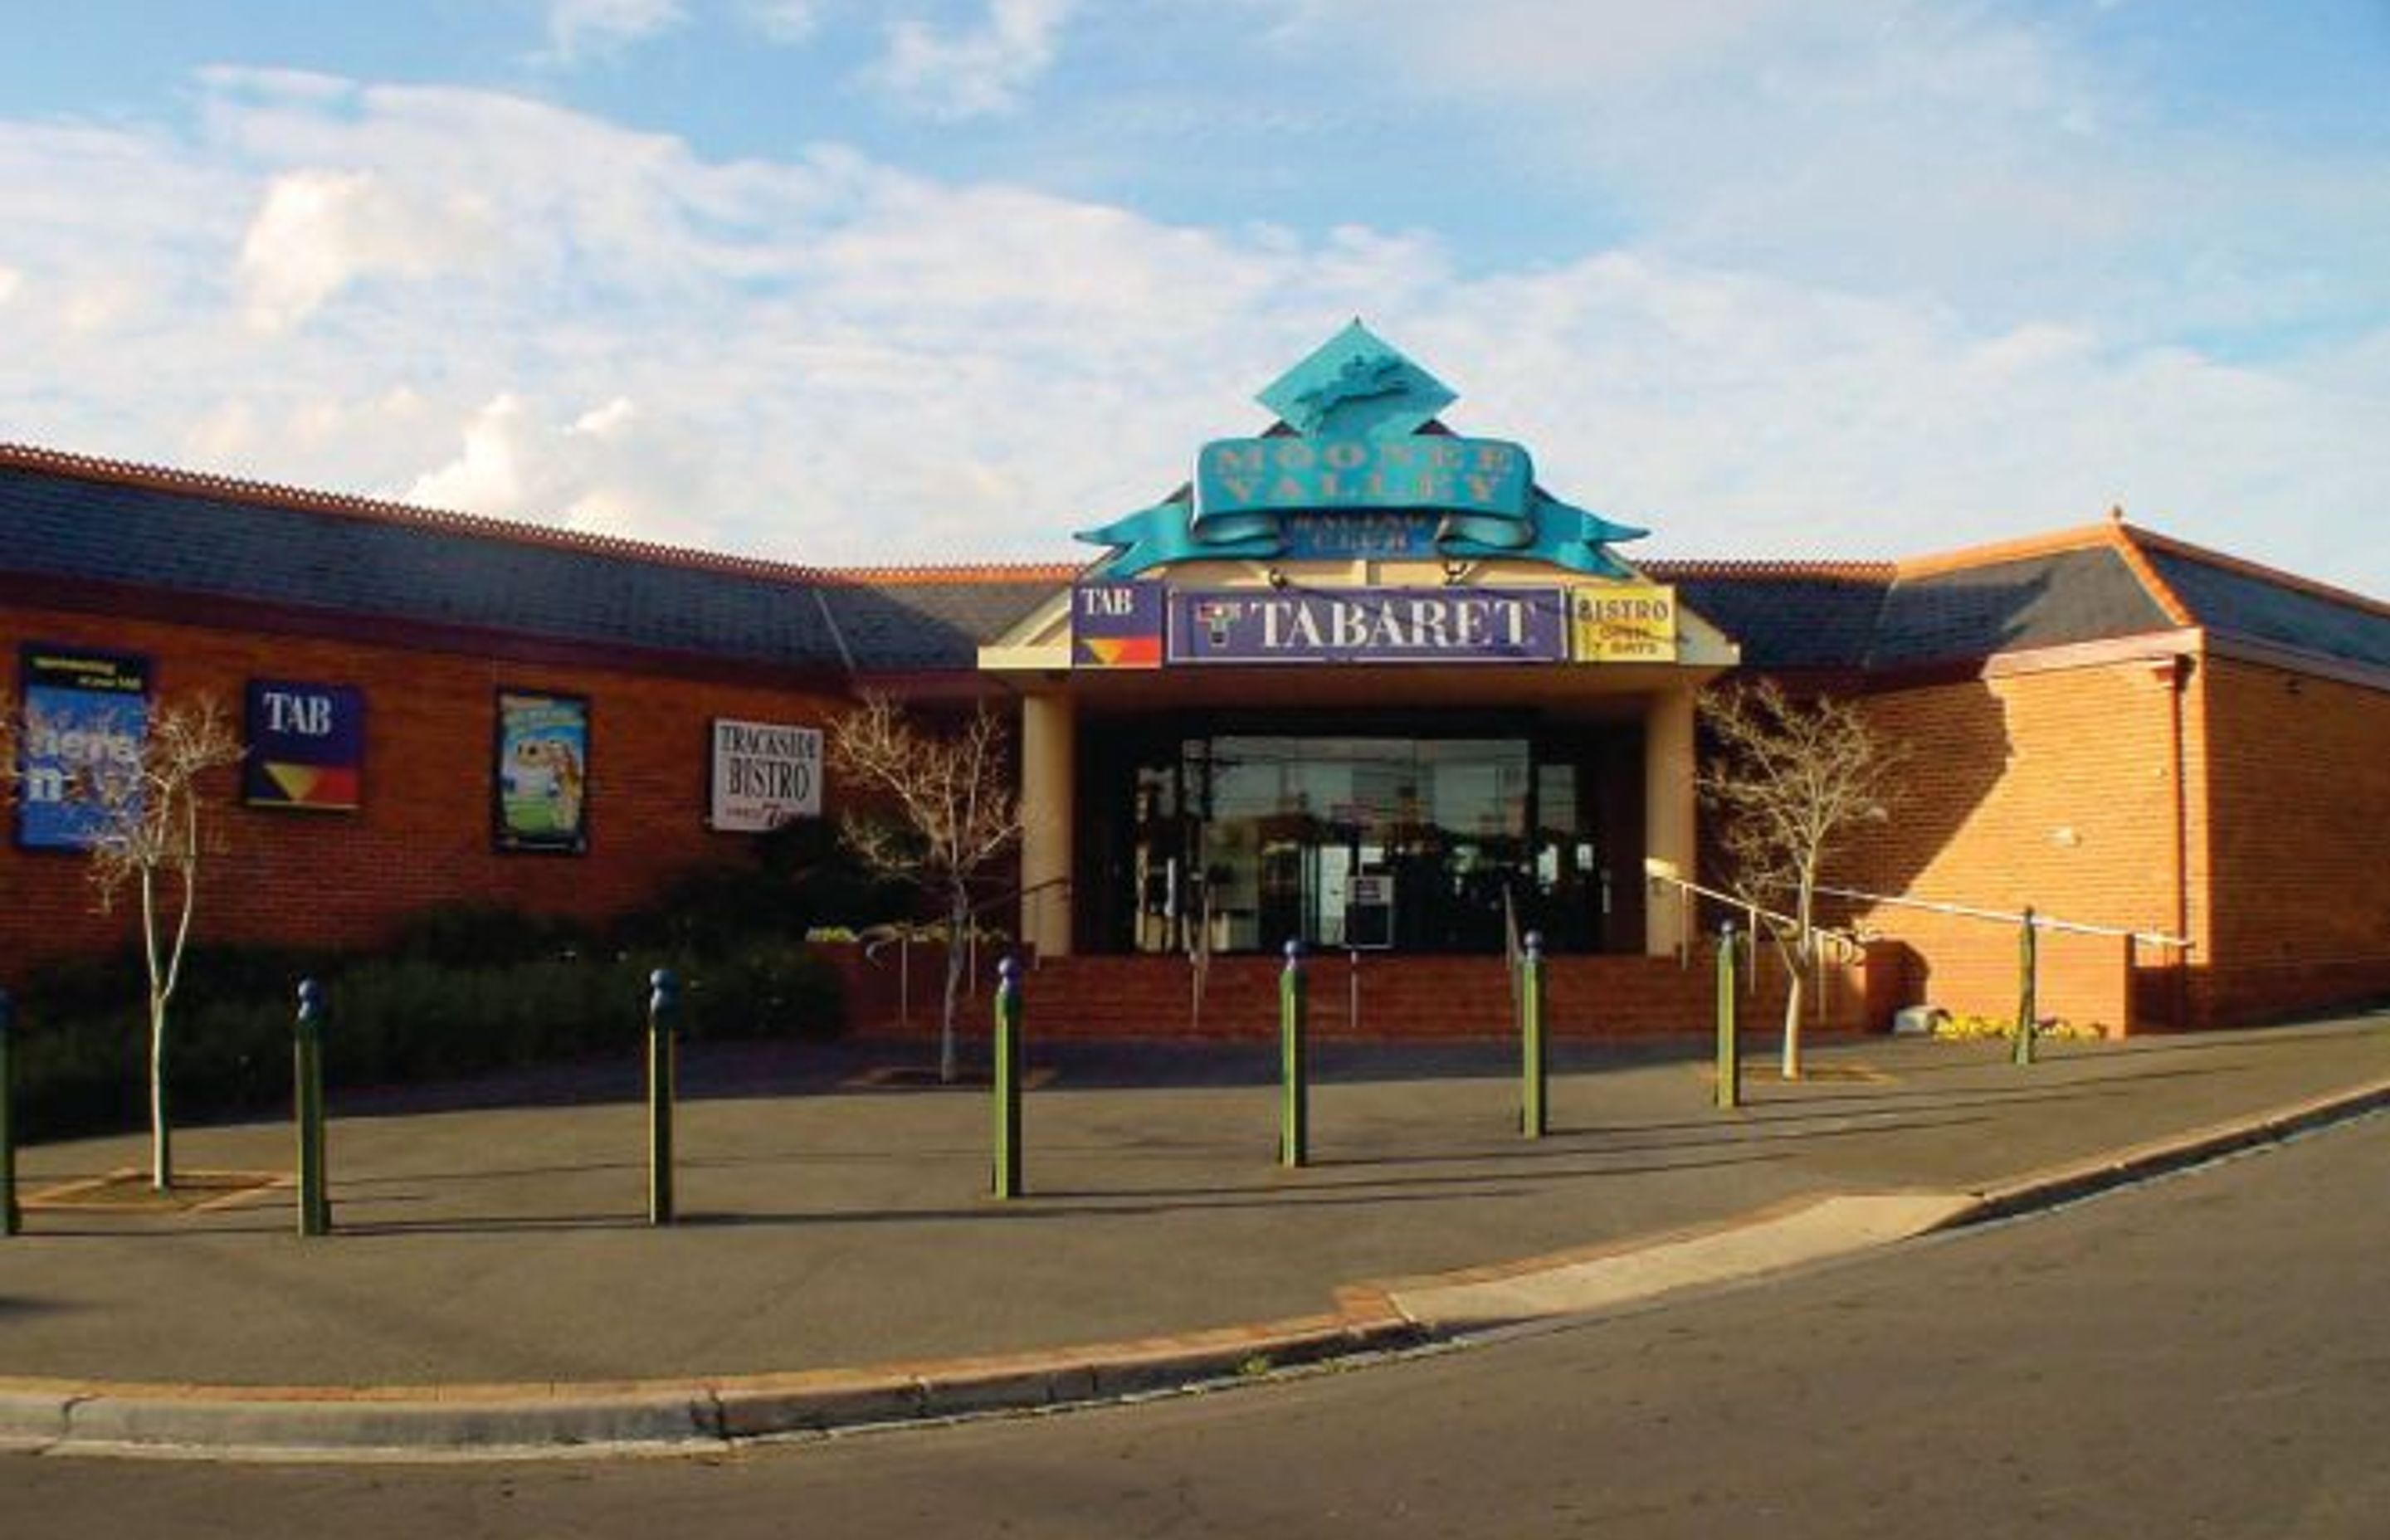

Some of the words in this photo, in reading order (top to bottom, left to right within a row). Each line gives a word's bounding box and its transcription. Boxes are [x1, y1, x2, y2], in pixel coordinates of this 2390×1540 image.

[1222, 474, 1500, 502] VALLEY
[1082, 587, 1134, 616] TAB
[1578, 599, 1669, 623] BISTRO
[1251, 599, 1537, 649] TABARET
[262, 693, 332, 734] TAB
[719, 724, 816, 759] TRACKSIDE
[729, 757, 811, 802] BISTRO
